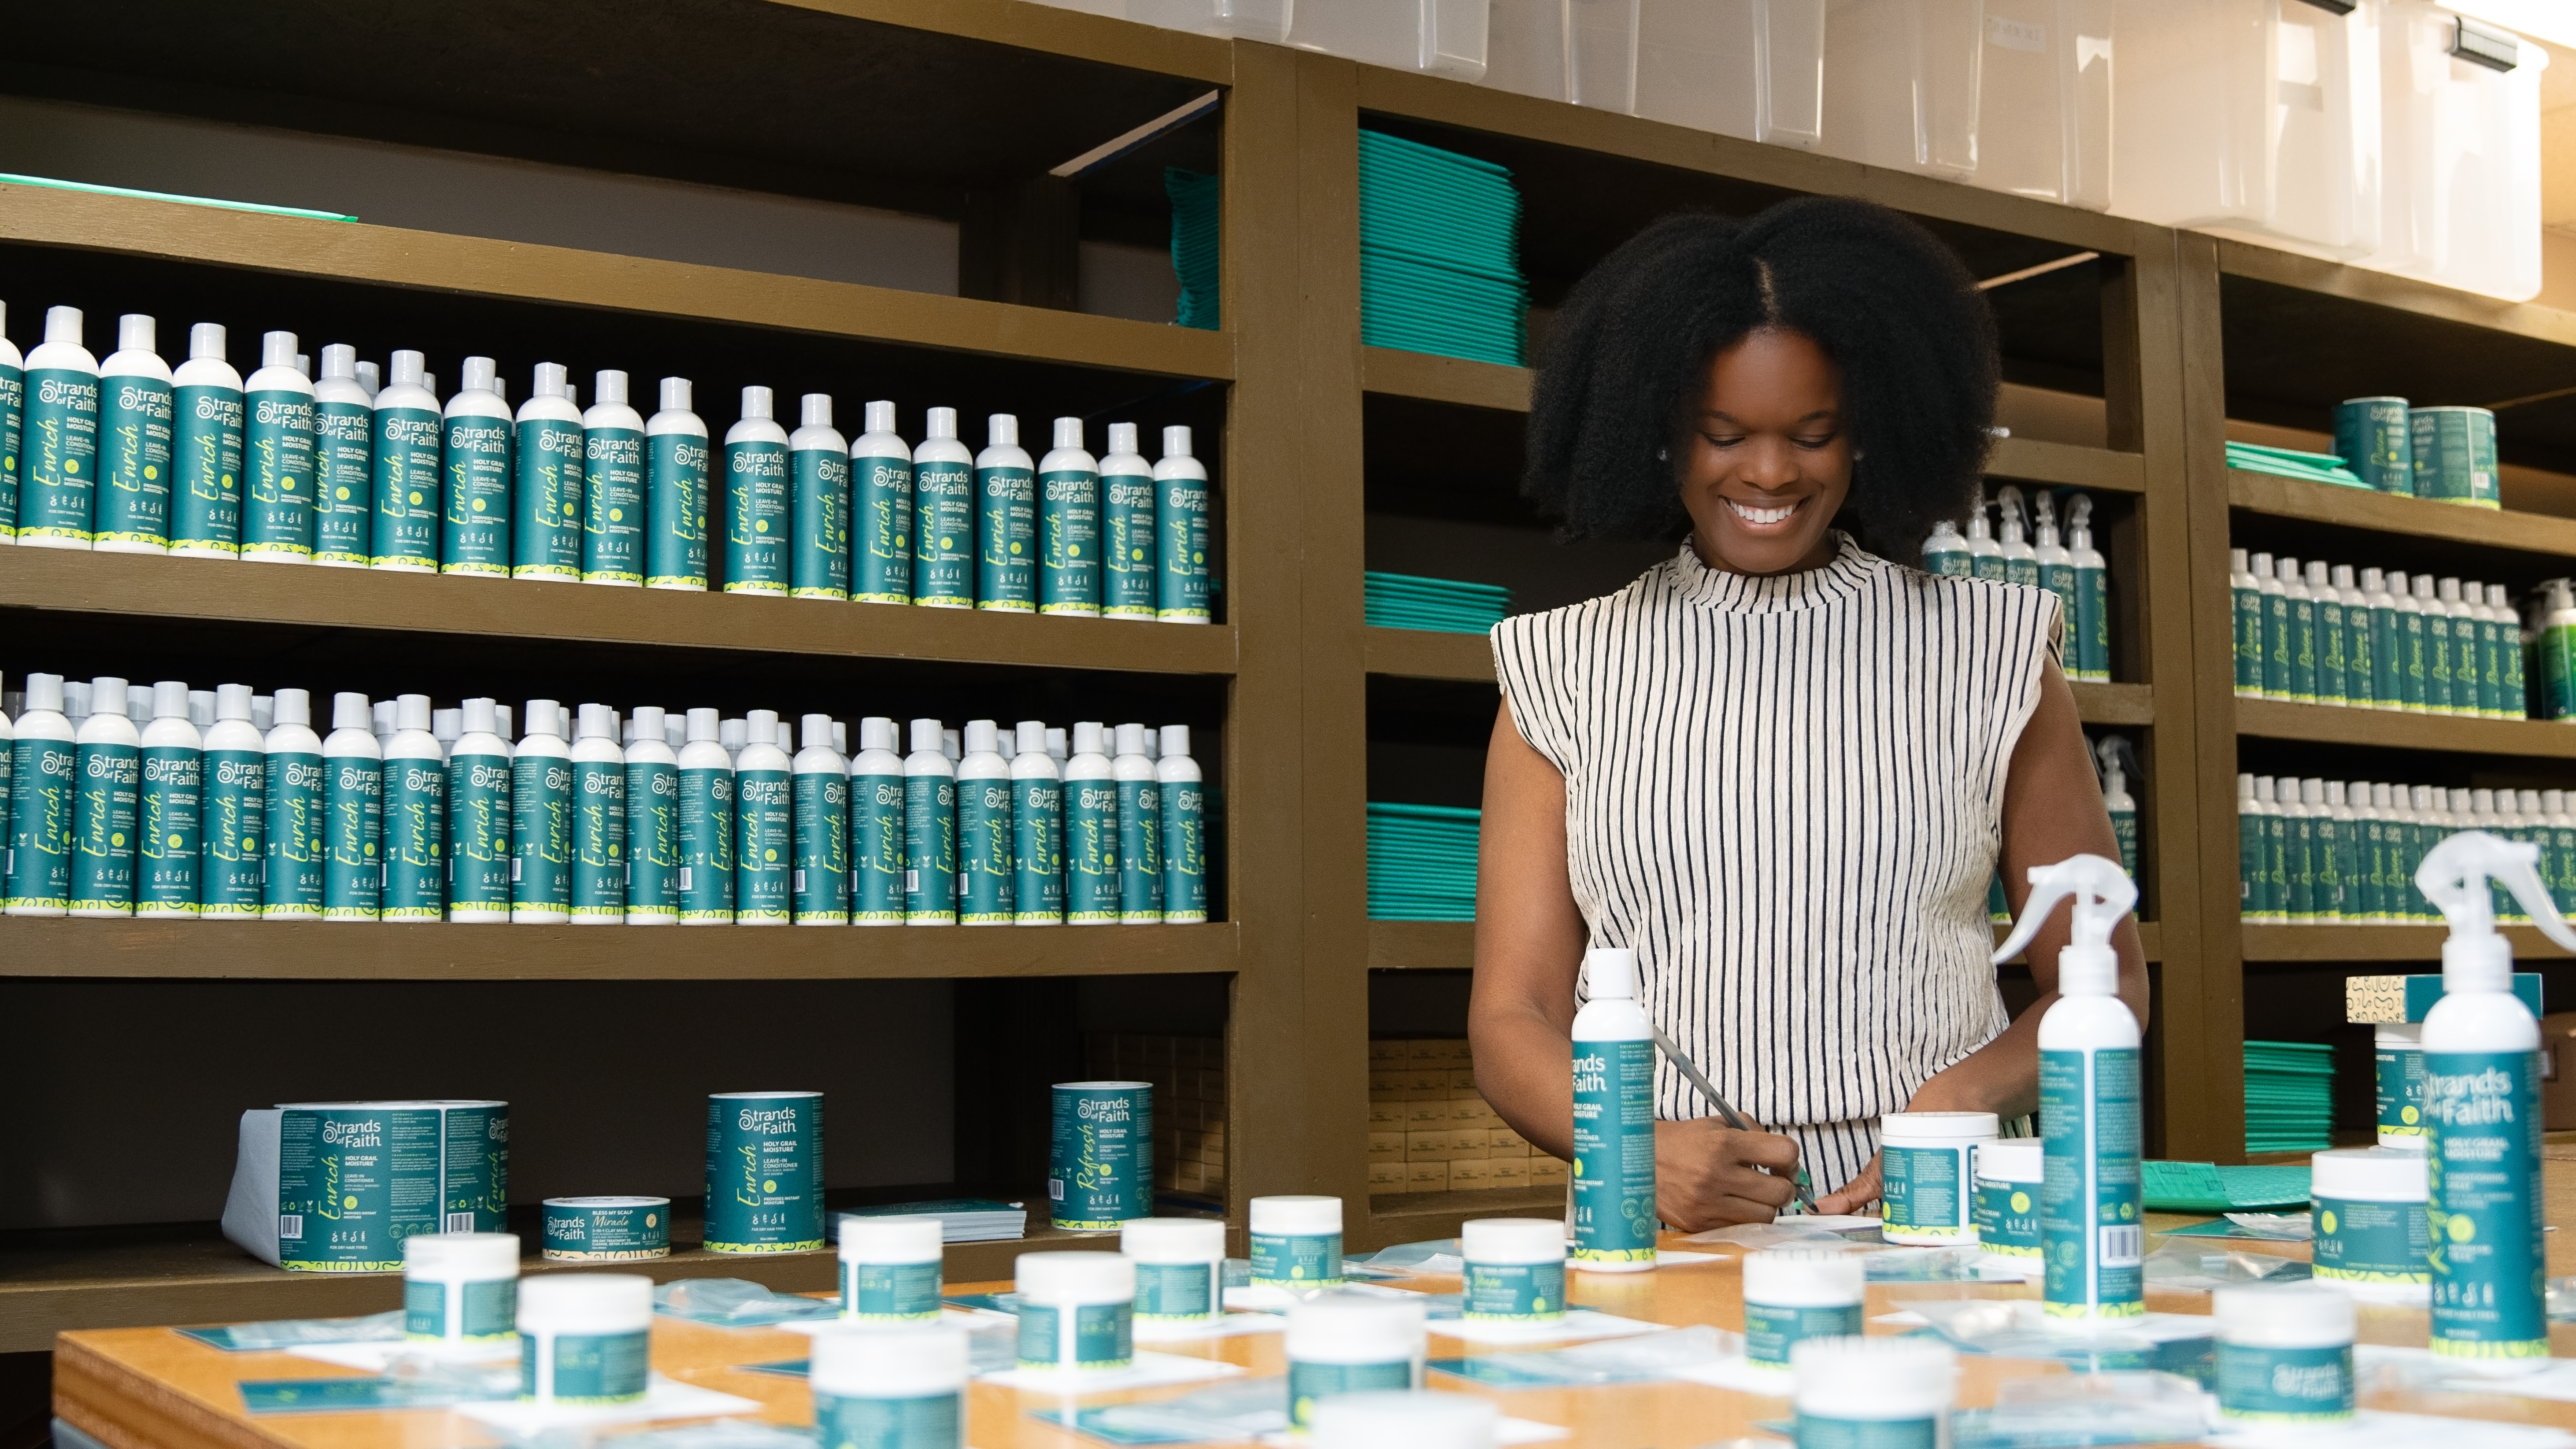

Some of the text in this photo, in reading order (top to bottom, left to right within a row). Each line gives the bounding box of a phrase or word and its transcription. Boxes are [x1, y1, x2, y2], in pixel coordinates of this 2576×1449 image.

[40, 379, 97, 403] Strands
[67, 396, 96, 413] Faith
[256, 401, 312, 423] Strands
[282, 416, 312, 431] Faith
[385, 418, 438, 440] Strands
[411, 432, 438, 448] Faith
[451, 426, 505, 448] Strands
[474, 440, 505, 454] Faith
[33, 417, 60, 486] Enrich
[587, 438, 639, 459] Strands
[611, 451, 639, 465] Faith
[191, 432, 218, 501] Enrich
[252, 436, 277, 503] Enrich
[733, 451, 784, 473] Strands
[746, 463, 784, 477] of Faith
[381, 453, 405, 518] Enrich
[919, 471, 968, 492] Strands
[932, 483, 968, 496] of Faith
[1046, 479, 1094, 501] Strands
[448, 461, 469, 525] Enrich
[585, 472, 606, 534] Enrich
[1066, 490, 1094, 504] Faith
[731, 484, 752, 546] Enrich
[918, 503, 938, 562] Enrich
[1046, 512, 1066, 569] Enrich
[145, 757, 200, 780] Strands
[159, 771, 200, 786] of Faith
[742, 779, 789, 801] Strands
[765, 792, 789, 805] Faith
[142, 791, 164, 859] Enrich
[740, 810, 762, 872] Enrich
[1080, 817, 1102, 876] Enrich
[739, 1107, 796, 1130] Strands
[1077, 1097, 1129, 1119] Strands
[1099, 1109, 1129, 1122] Faith
[2443, 1096, 2515, 1126] Faith
[323, 1119, 381, 1143] Strands
[763, 1120, 796, 1135] Faith
[345, 1133, 381, 1148] Faith
[1077, 1123, 1100, 1190] Refresh
[737, 1143, 761, 1207] Enrich
[1985, 1180, 2010, 1189] MOISTURE
[318, 1153, 341, 1220] Enrich
[548, 1216, 585, 1235] Strands
[592, 1216, 629, 1227] Miracle
[559, 1228, 585, 1240] Faith
